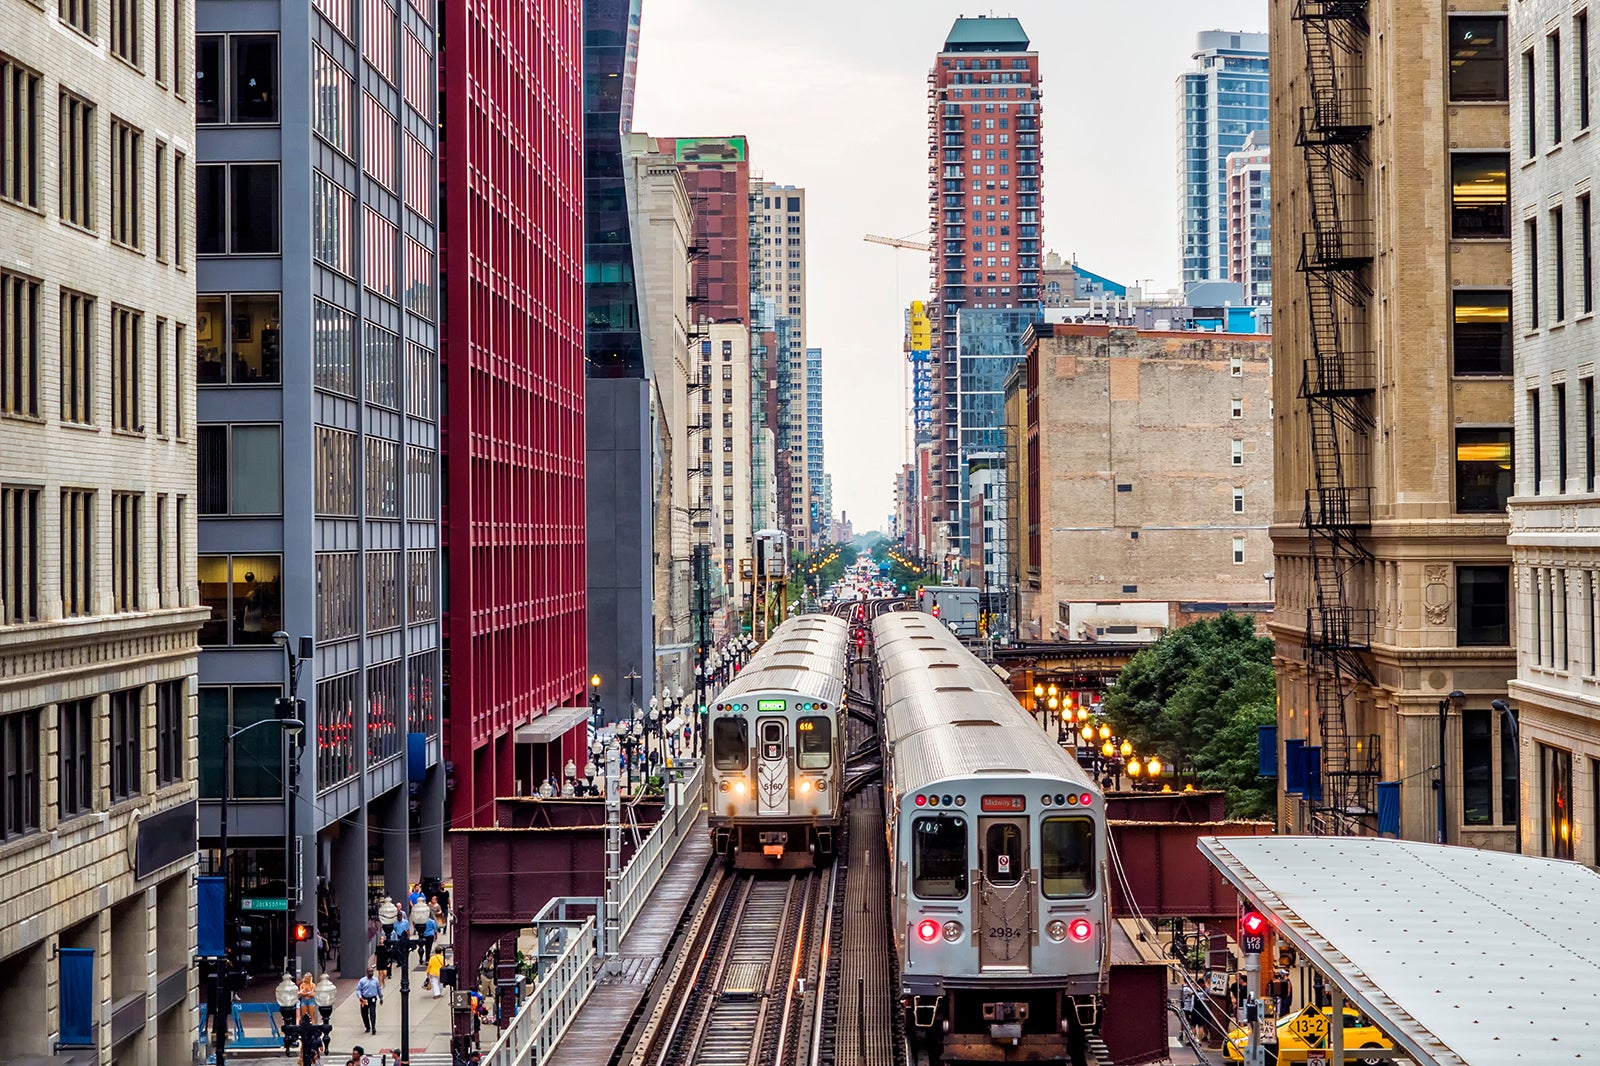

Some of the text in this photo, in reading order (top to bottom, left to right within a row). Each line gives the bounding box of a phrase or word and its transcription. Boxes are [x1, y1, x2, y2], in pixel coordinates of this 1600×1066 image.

[800, 722, 814, 731] 616
[985, 798, 1010, 807] Midway
[989, 927, 1021, 938] 2984
[1246, 936, 1261, 944] LP2
